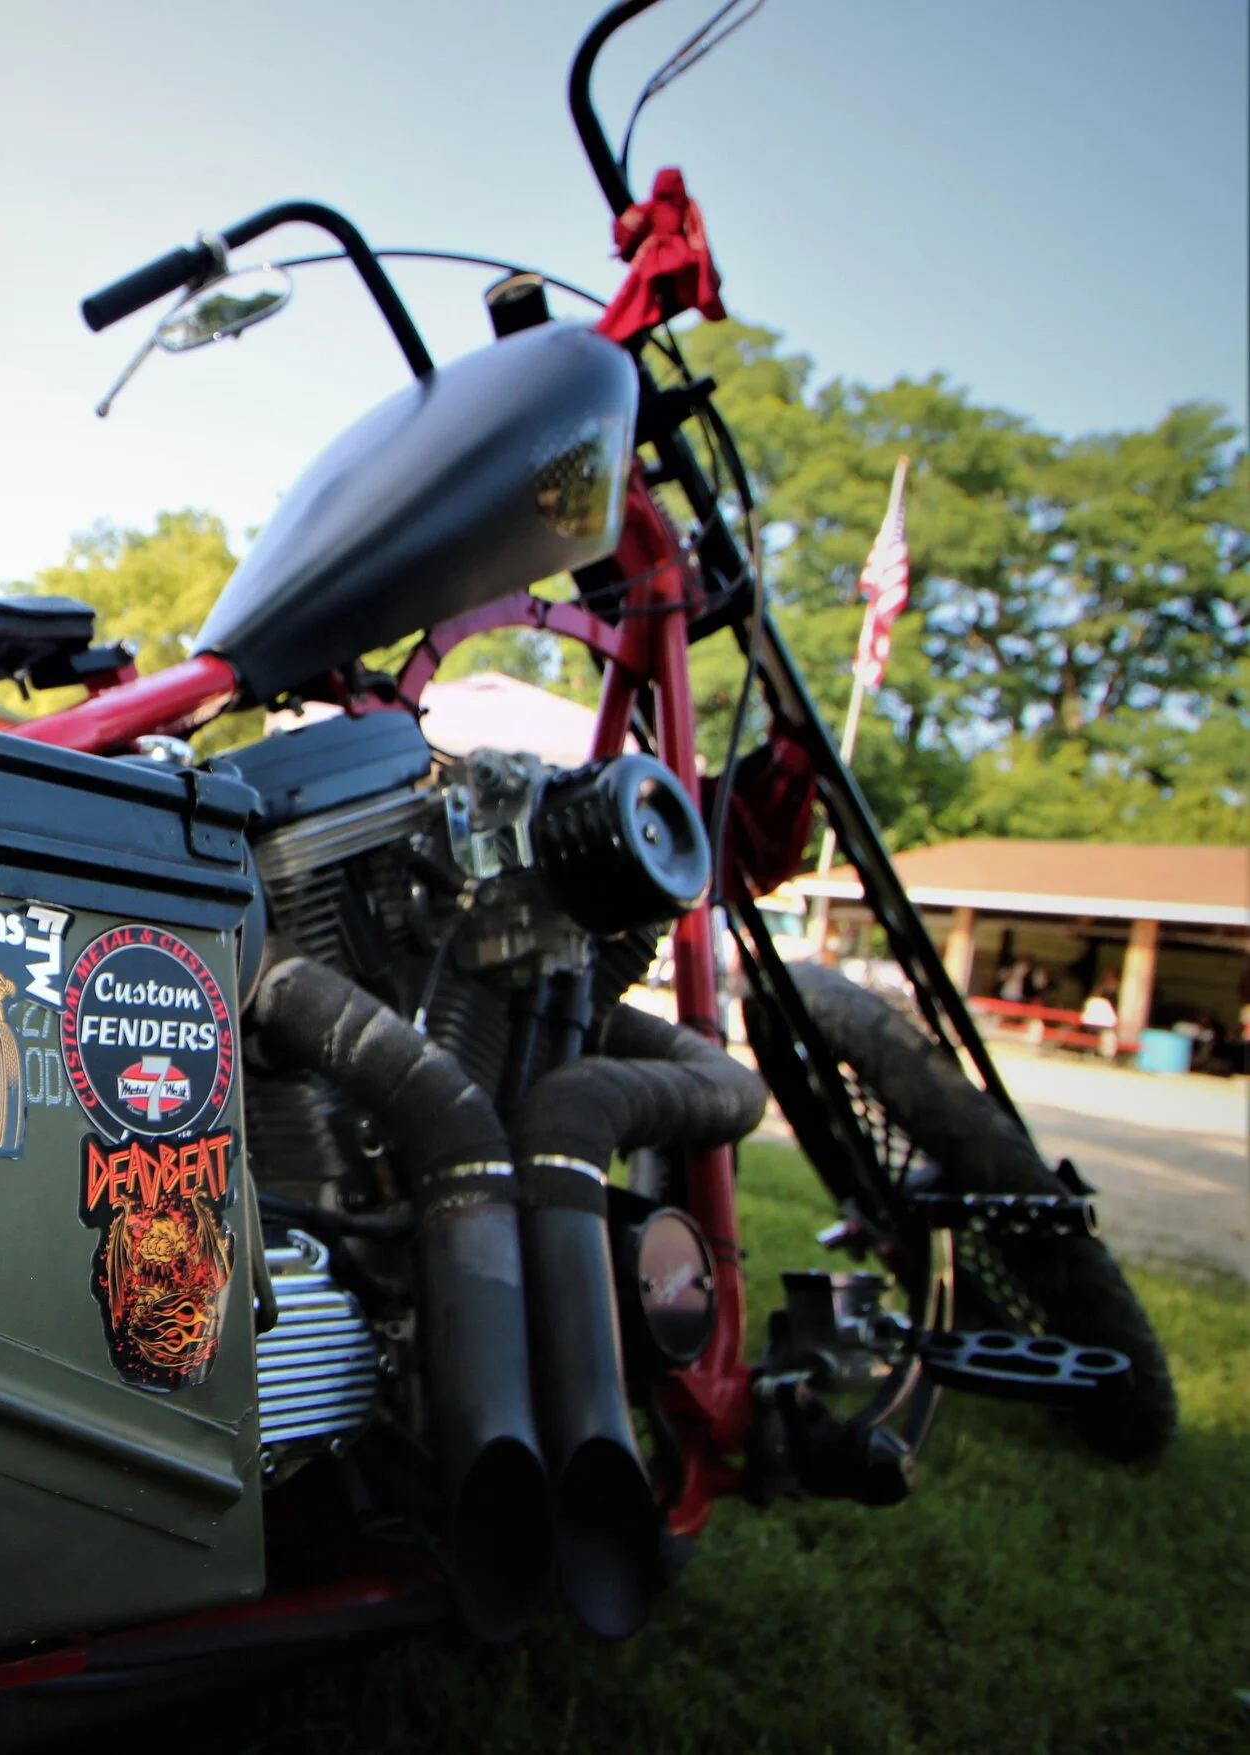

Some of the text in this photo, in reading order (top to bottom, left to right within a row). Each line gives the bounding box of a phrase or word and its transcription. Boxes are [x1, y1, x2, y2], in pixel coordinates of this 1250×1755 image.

[76, 928, 136, 984] METAL
[139, 928, 154, 944] &
[94, 972, 203, 1011] Custom
[158, 931, 228, 1021] CUSTOM
[63, 986, 99, 1107] CUSTOM
[81, 1015, 216, 1052] FENDERS
[211, 1030, 233, 1109] SIZES
[87, 1134, 232, 1211] DEADBEAT
